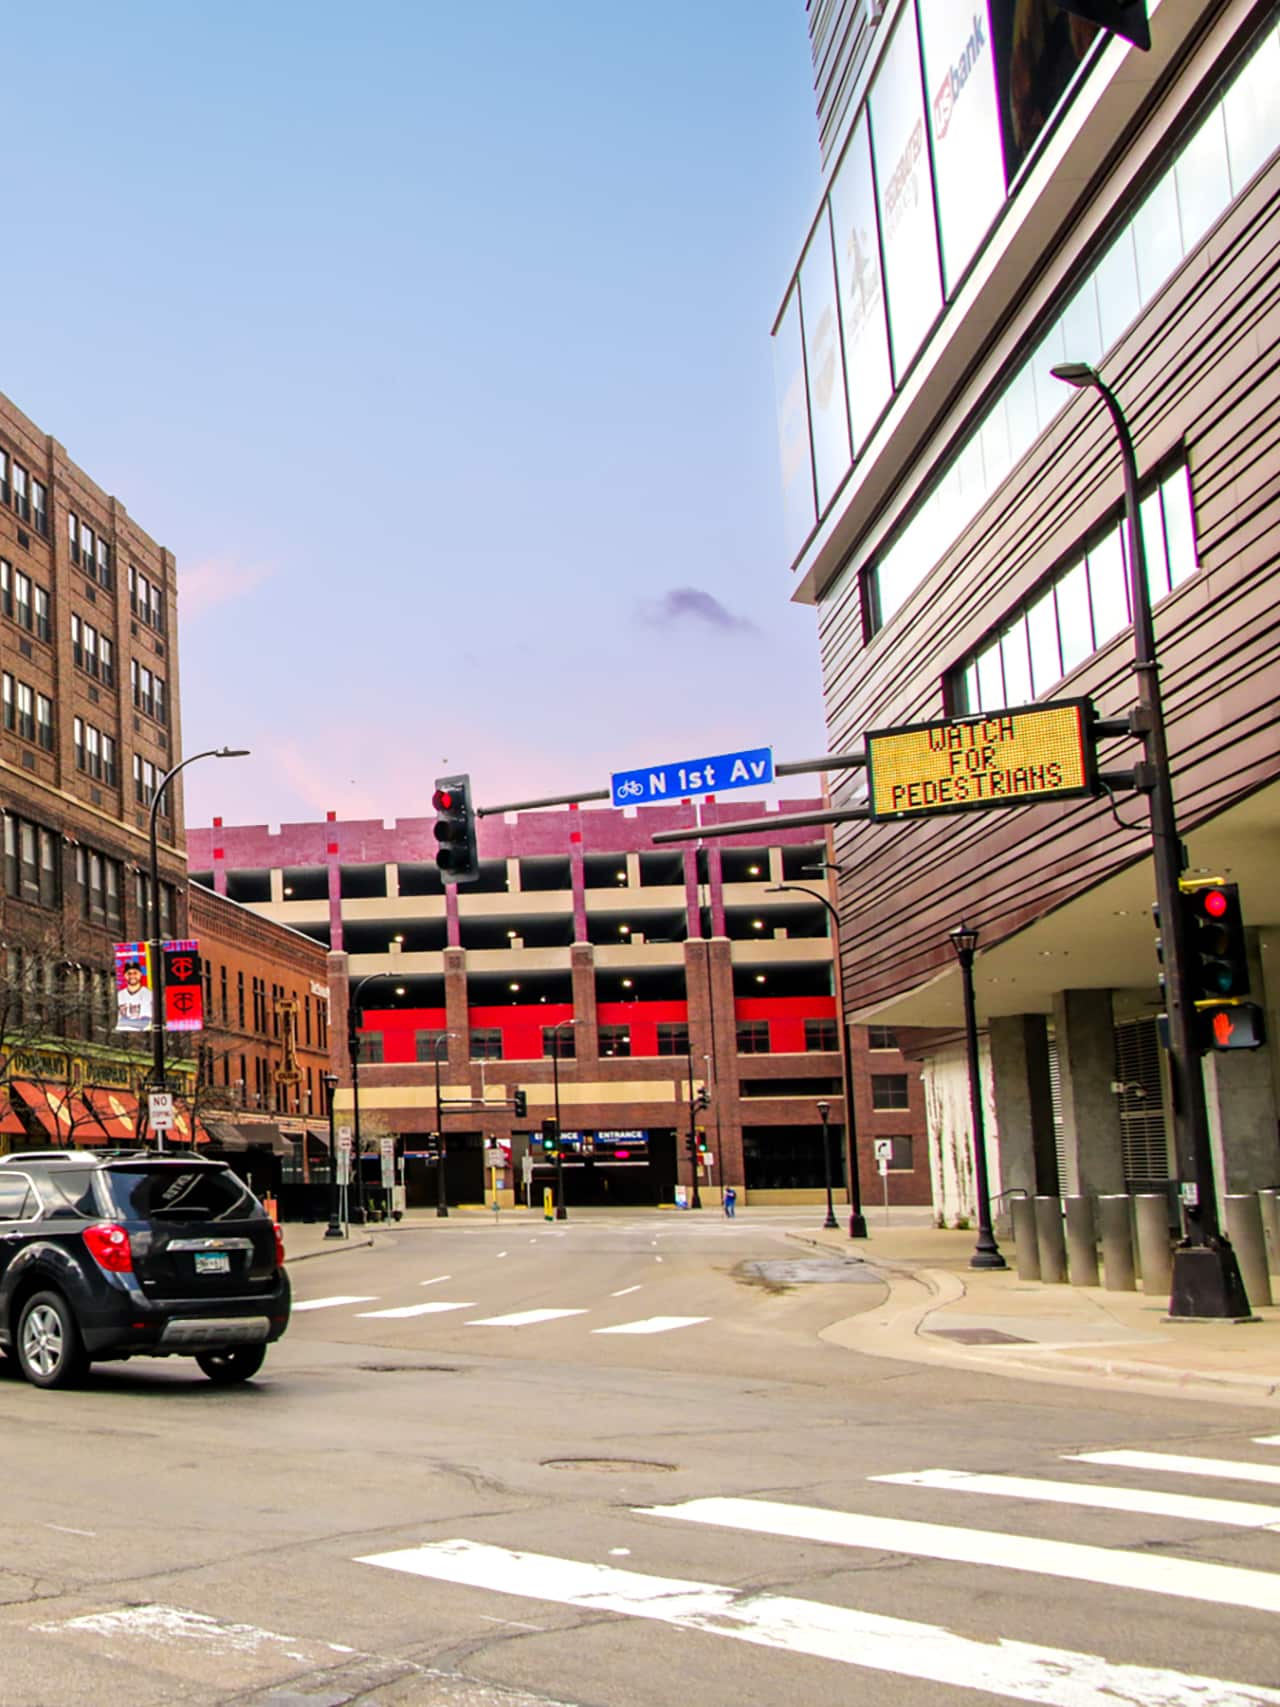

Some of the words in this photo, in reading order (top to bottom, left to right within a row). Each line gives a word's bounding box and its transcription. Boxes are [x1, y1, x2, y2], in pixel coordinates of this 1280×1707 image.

[929, 717, 1013, 751] WATCH
[950, 745, 996, 774] FOR
[649, 774, 667, 795] N
[679, 764, 714, 791] 1st
[730, 757, 767, 782] Av
[891, 764, 1063, 809] PEDESTRIANS
[153, 1096, 167, 1106] NO
[598, 1131, 643, 1139] ENTRANCE
